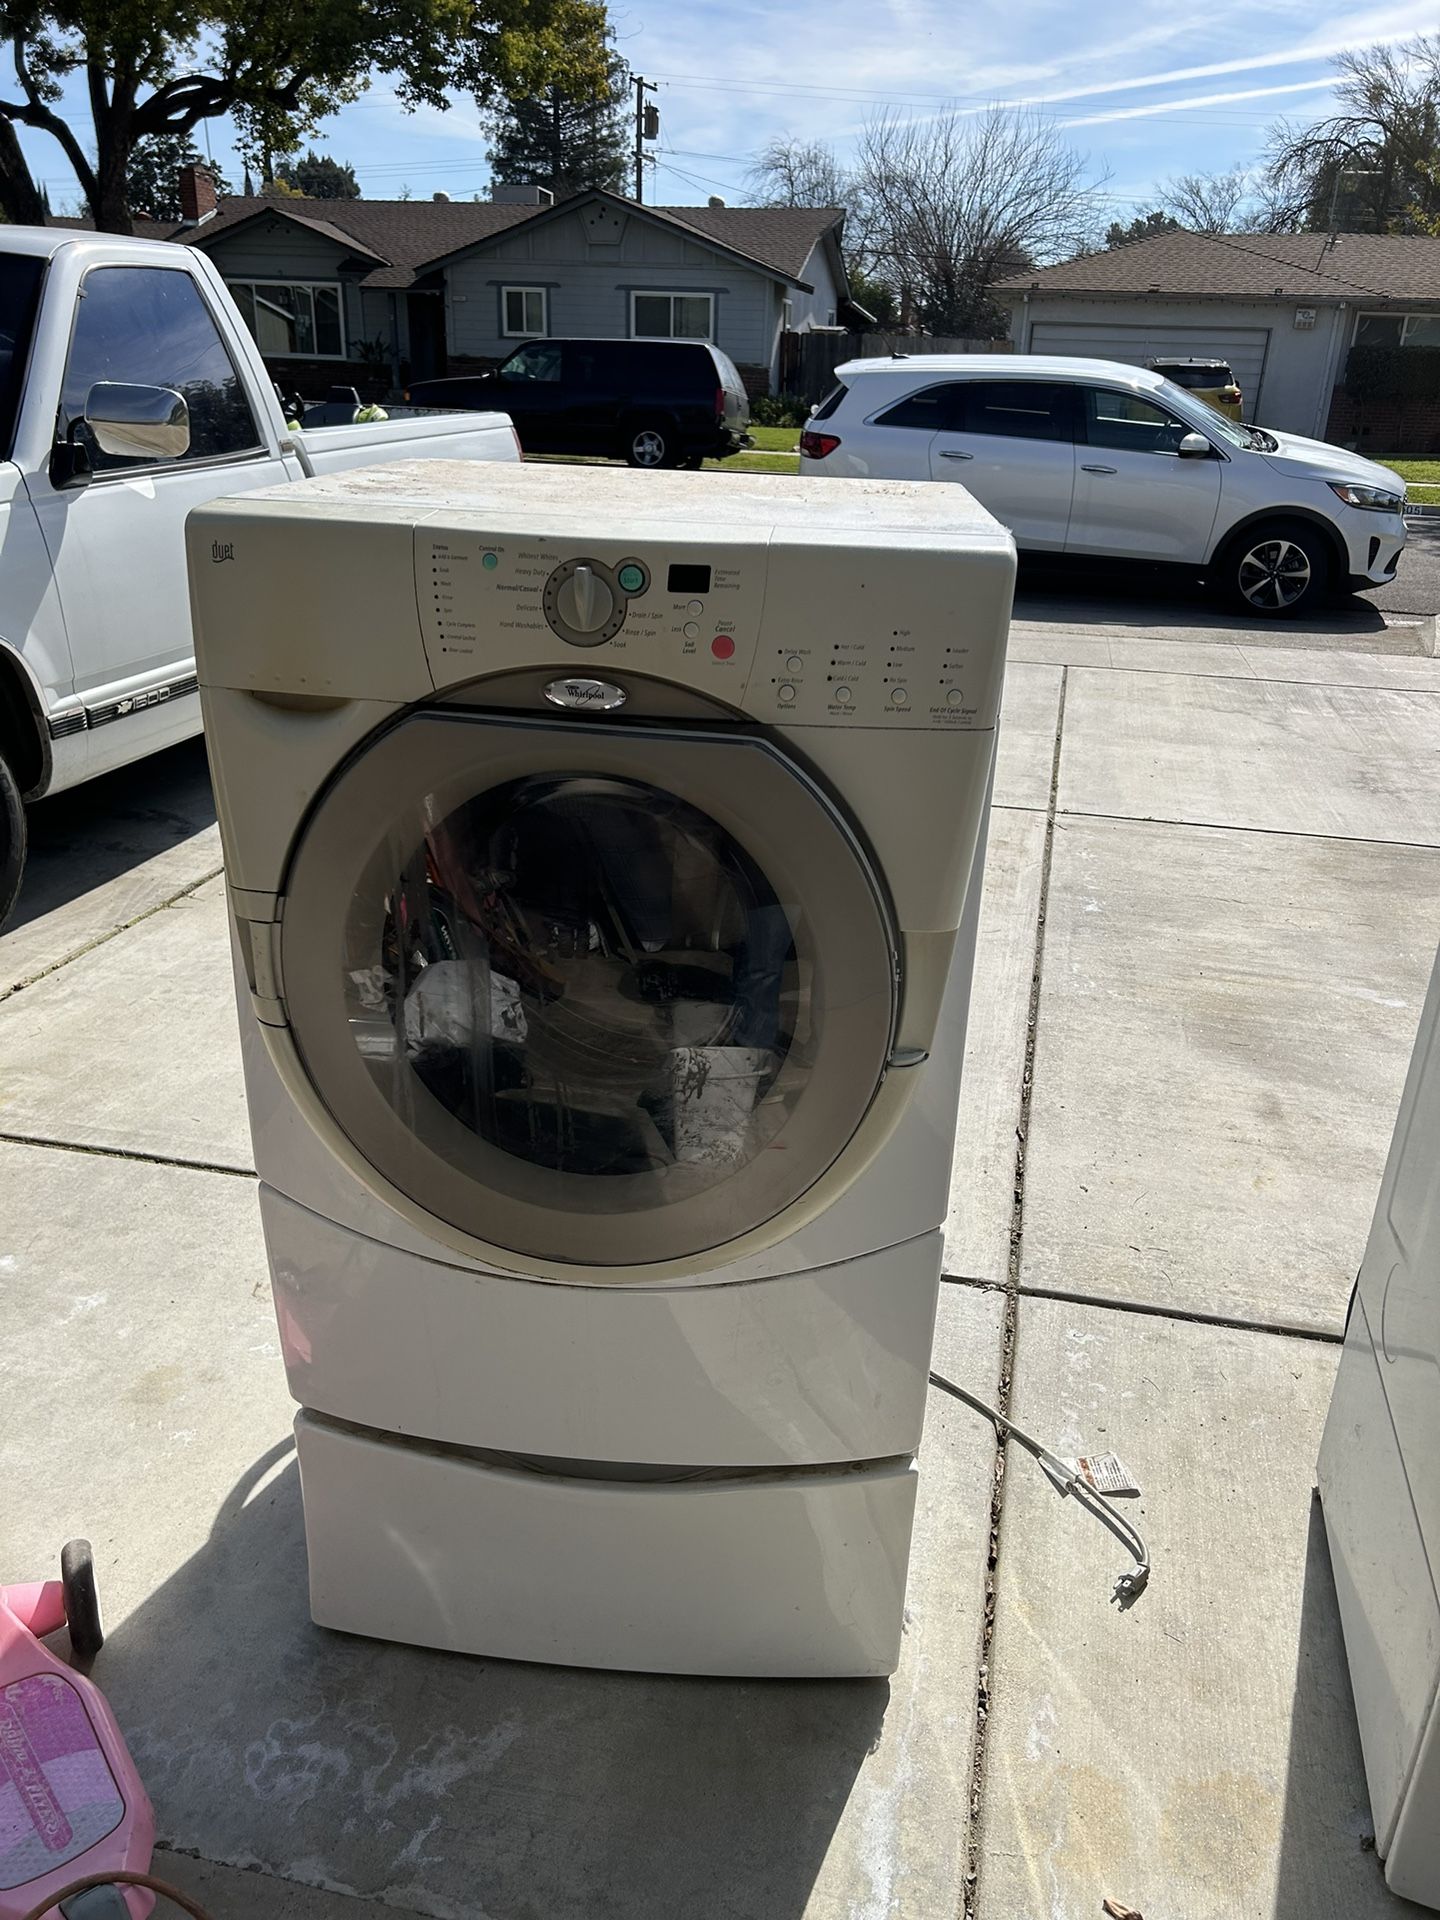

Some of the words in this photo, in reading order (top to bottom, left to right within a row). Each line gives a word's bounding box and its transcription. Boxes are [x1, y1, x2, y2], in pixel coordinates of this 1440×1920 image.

[212, 539, 234, 561] duet
[518, 552, 539, 560] Whitest
[540, 552, 558, 561] Whites
[515, 568, 532, 576] Heavy
[533, 568, 546, 577] Duty
[624, 576, 639, 584] Start
[496, 584, 539, 592] Normal/Casual
[644, 629, 656, 638] Spin
[132, 687, 170, 711] 1500
[567, 688, 605, 701] Whirlpool
